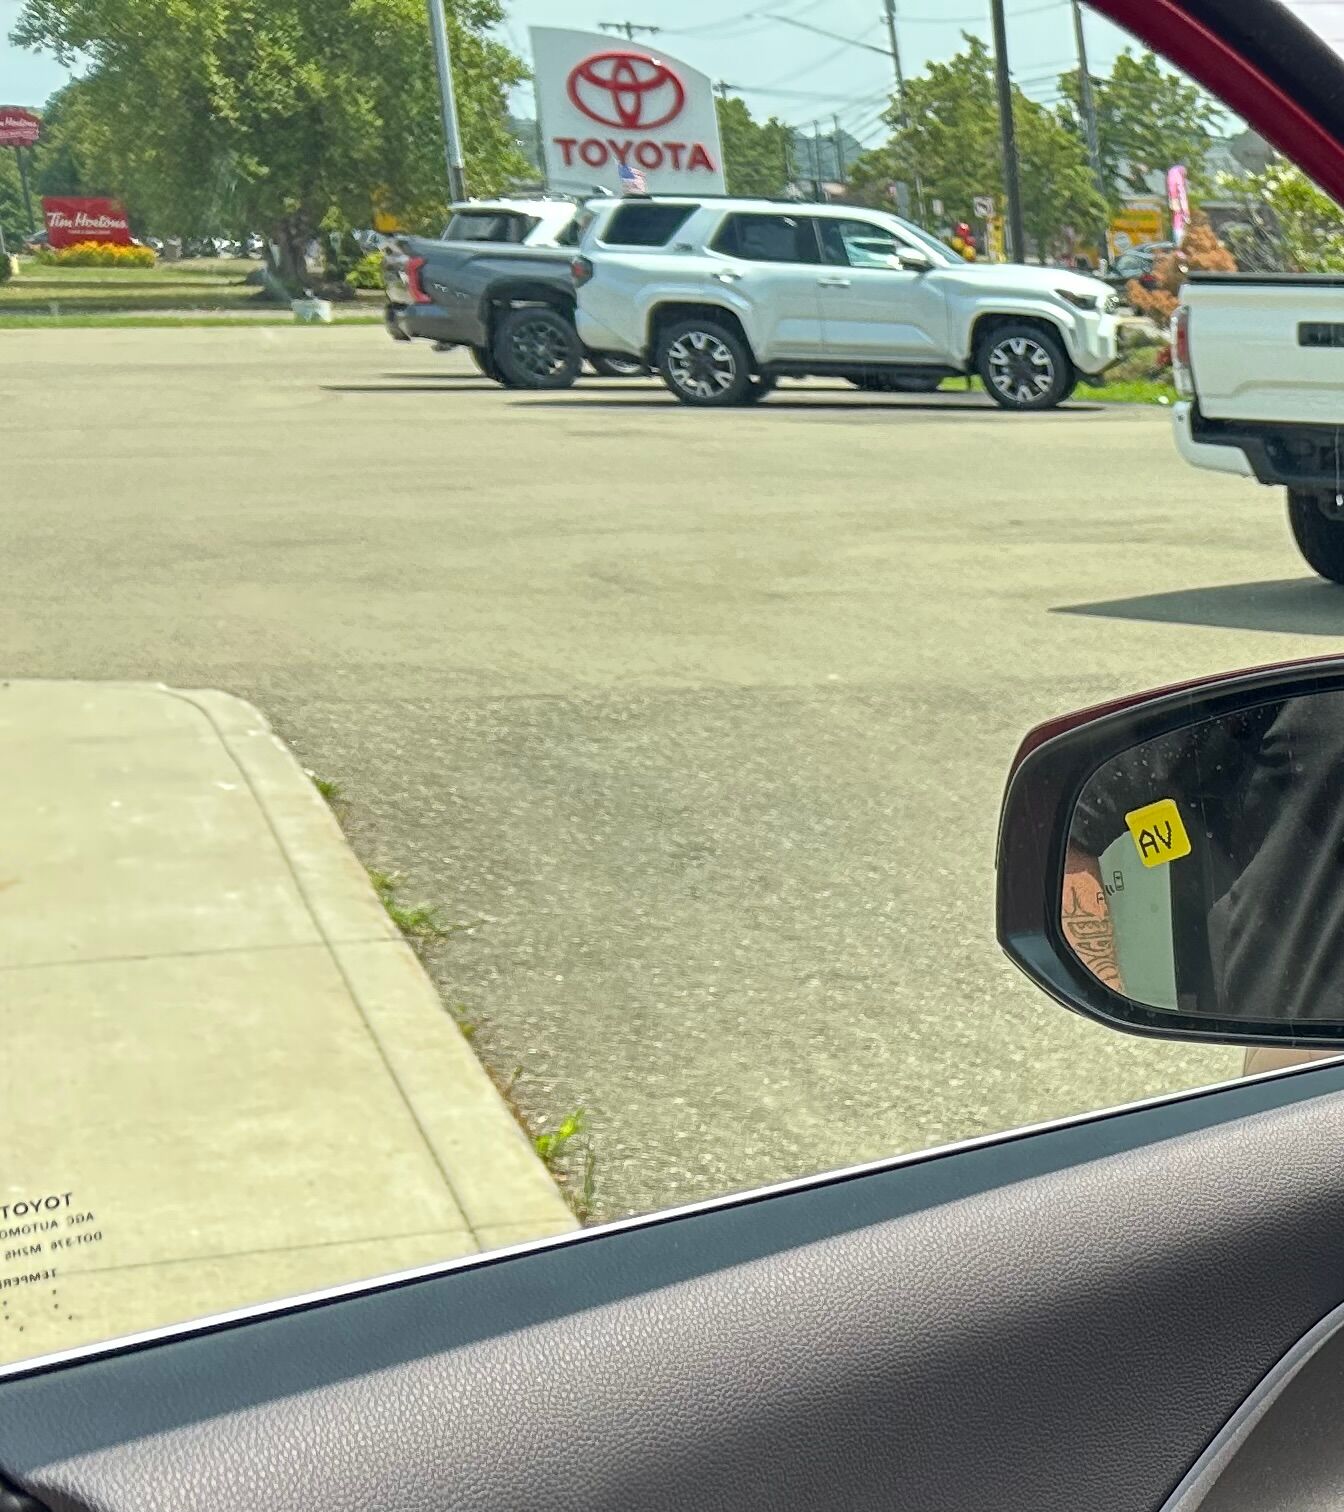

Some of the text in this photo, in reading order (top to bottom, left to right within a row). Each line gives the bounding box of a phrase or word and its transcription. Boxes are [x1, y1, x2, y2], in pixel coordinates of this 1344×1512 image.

[553, 138, 715, 172] TOYOTA
[47, 212, 128, 229] Tim Hortons
[1138, 820, 1173, 858] AV
